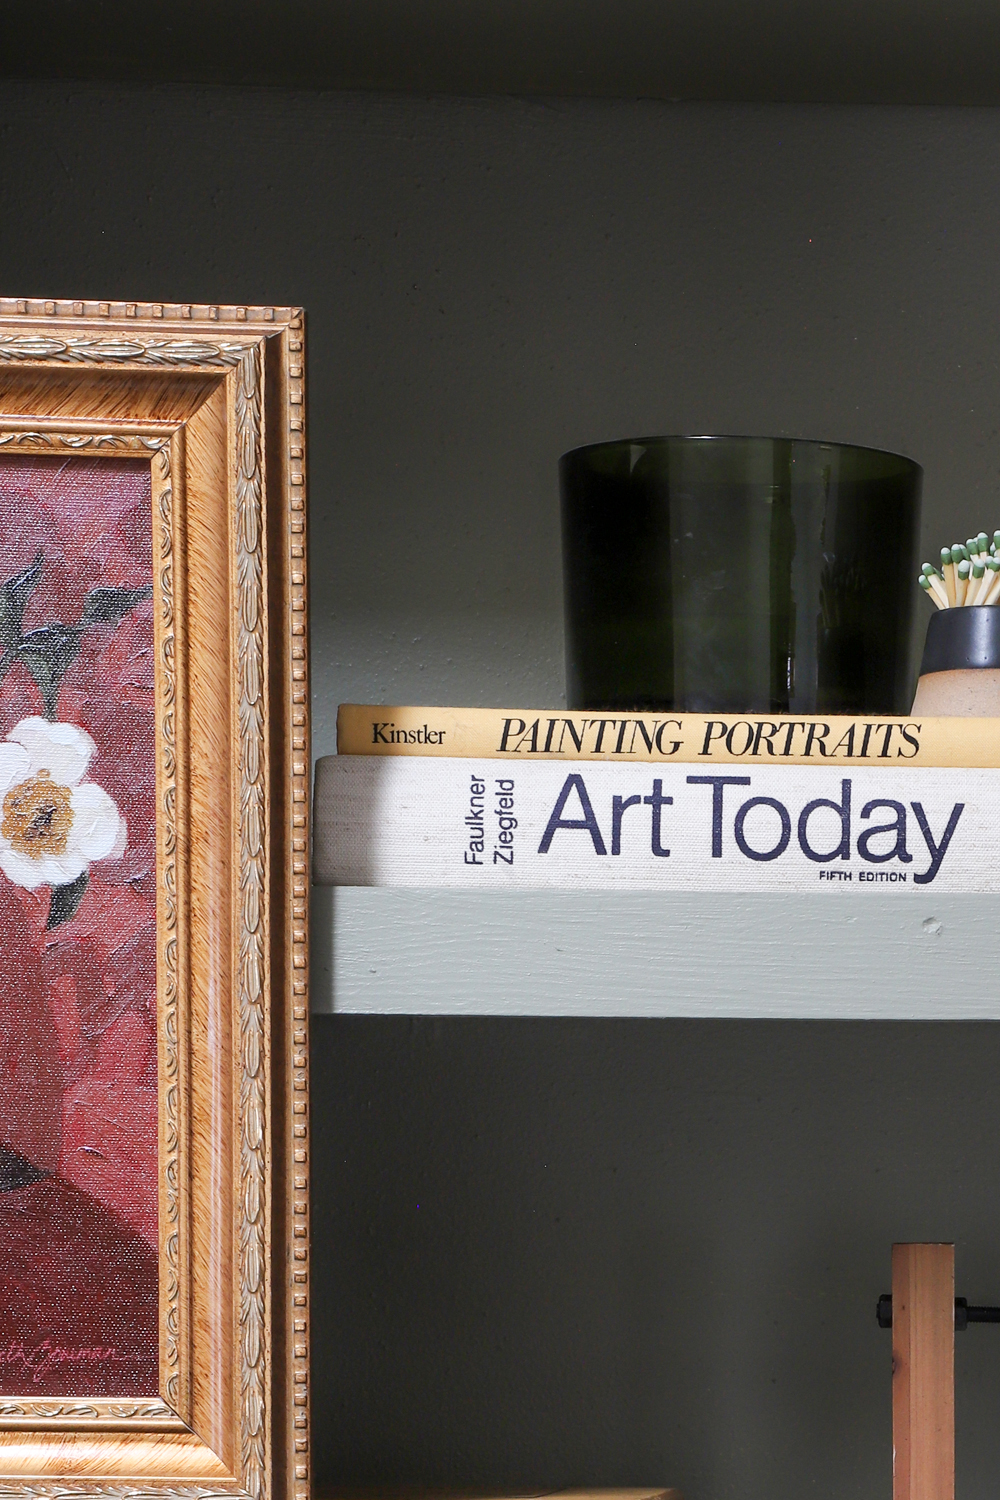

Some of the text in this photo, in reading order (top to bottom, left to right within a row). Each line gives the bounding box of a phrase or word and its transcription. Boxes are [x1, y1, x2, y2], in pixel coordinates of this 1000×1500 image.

[371, 721, 447, 747] Kinstler
[495, 717, 923, 761] PAINTING PORTRAITS
[464, 774, 487, 867] Faulkner
[493, 778, 515, 866] Ziegfeld
[537, 772, 966, 885] Art Today
[818, 870, 908, 883] FIFTH EDITION
